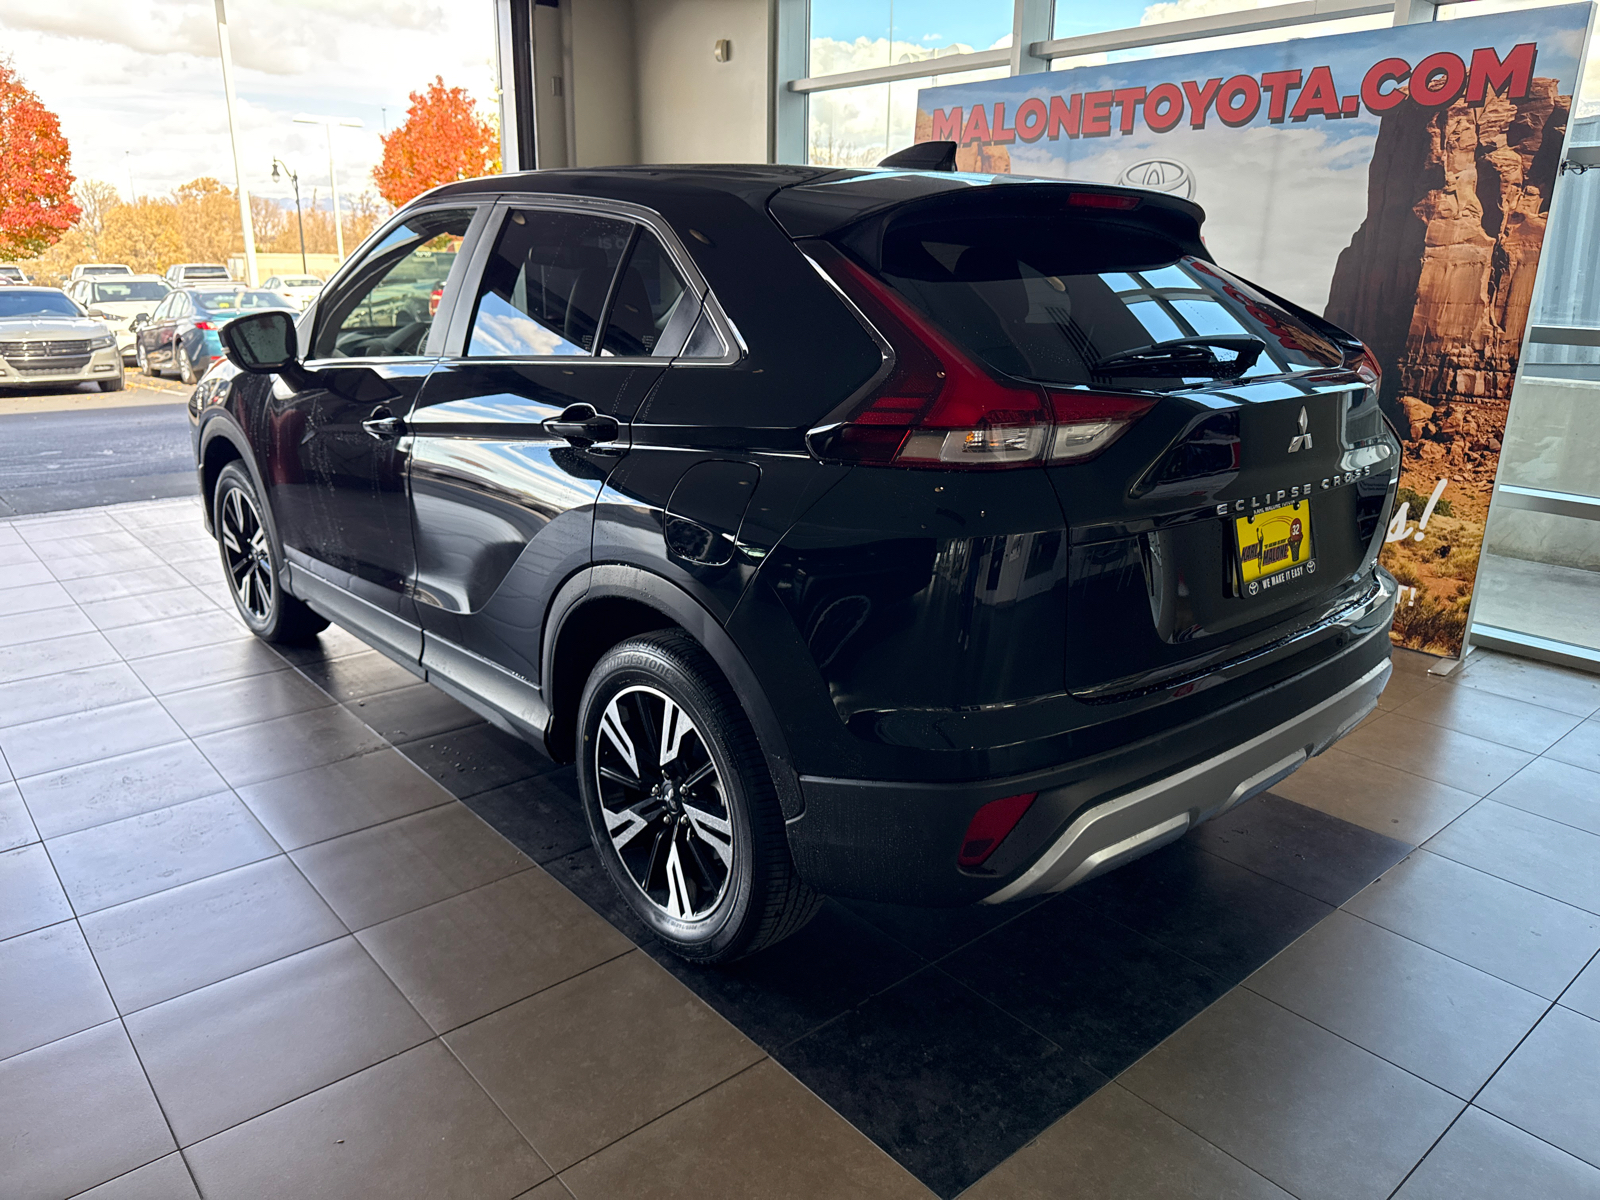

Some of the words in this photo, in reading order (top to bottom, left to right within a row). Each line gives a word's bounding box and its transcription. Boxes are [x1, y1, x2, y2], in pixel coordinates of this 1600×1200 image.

[931, 42, 1538, 148] MALONETOYOTA.COM
[1216, 484, 1312, 515] ECLIPSE
[1320, 466, 1371, 490] CROSS
[1292, 523, 1300, 536] 32
[1242, 543, 1259, 563] KARL
[1263, 543, 1289, 566] MALONE
[1262, 579, 1271, 589] WE
[1271, 573, 1285, 585] MAKE
[1285, 571, 1291, 580] IT
[1291, 566, 1303, 577] EASY
